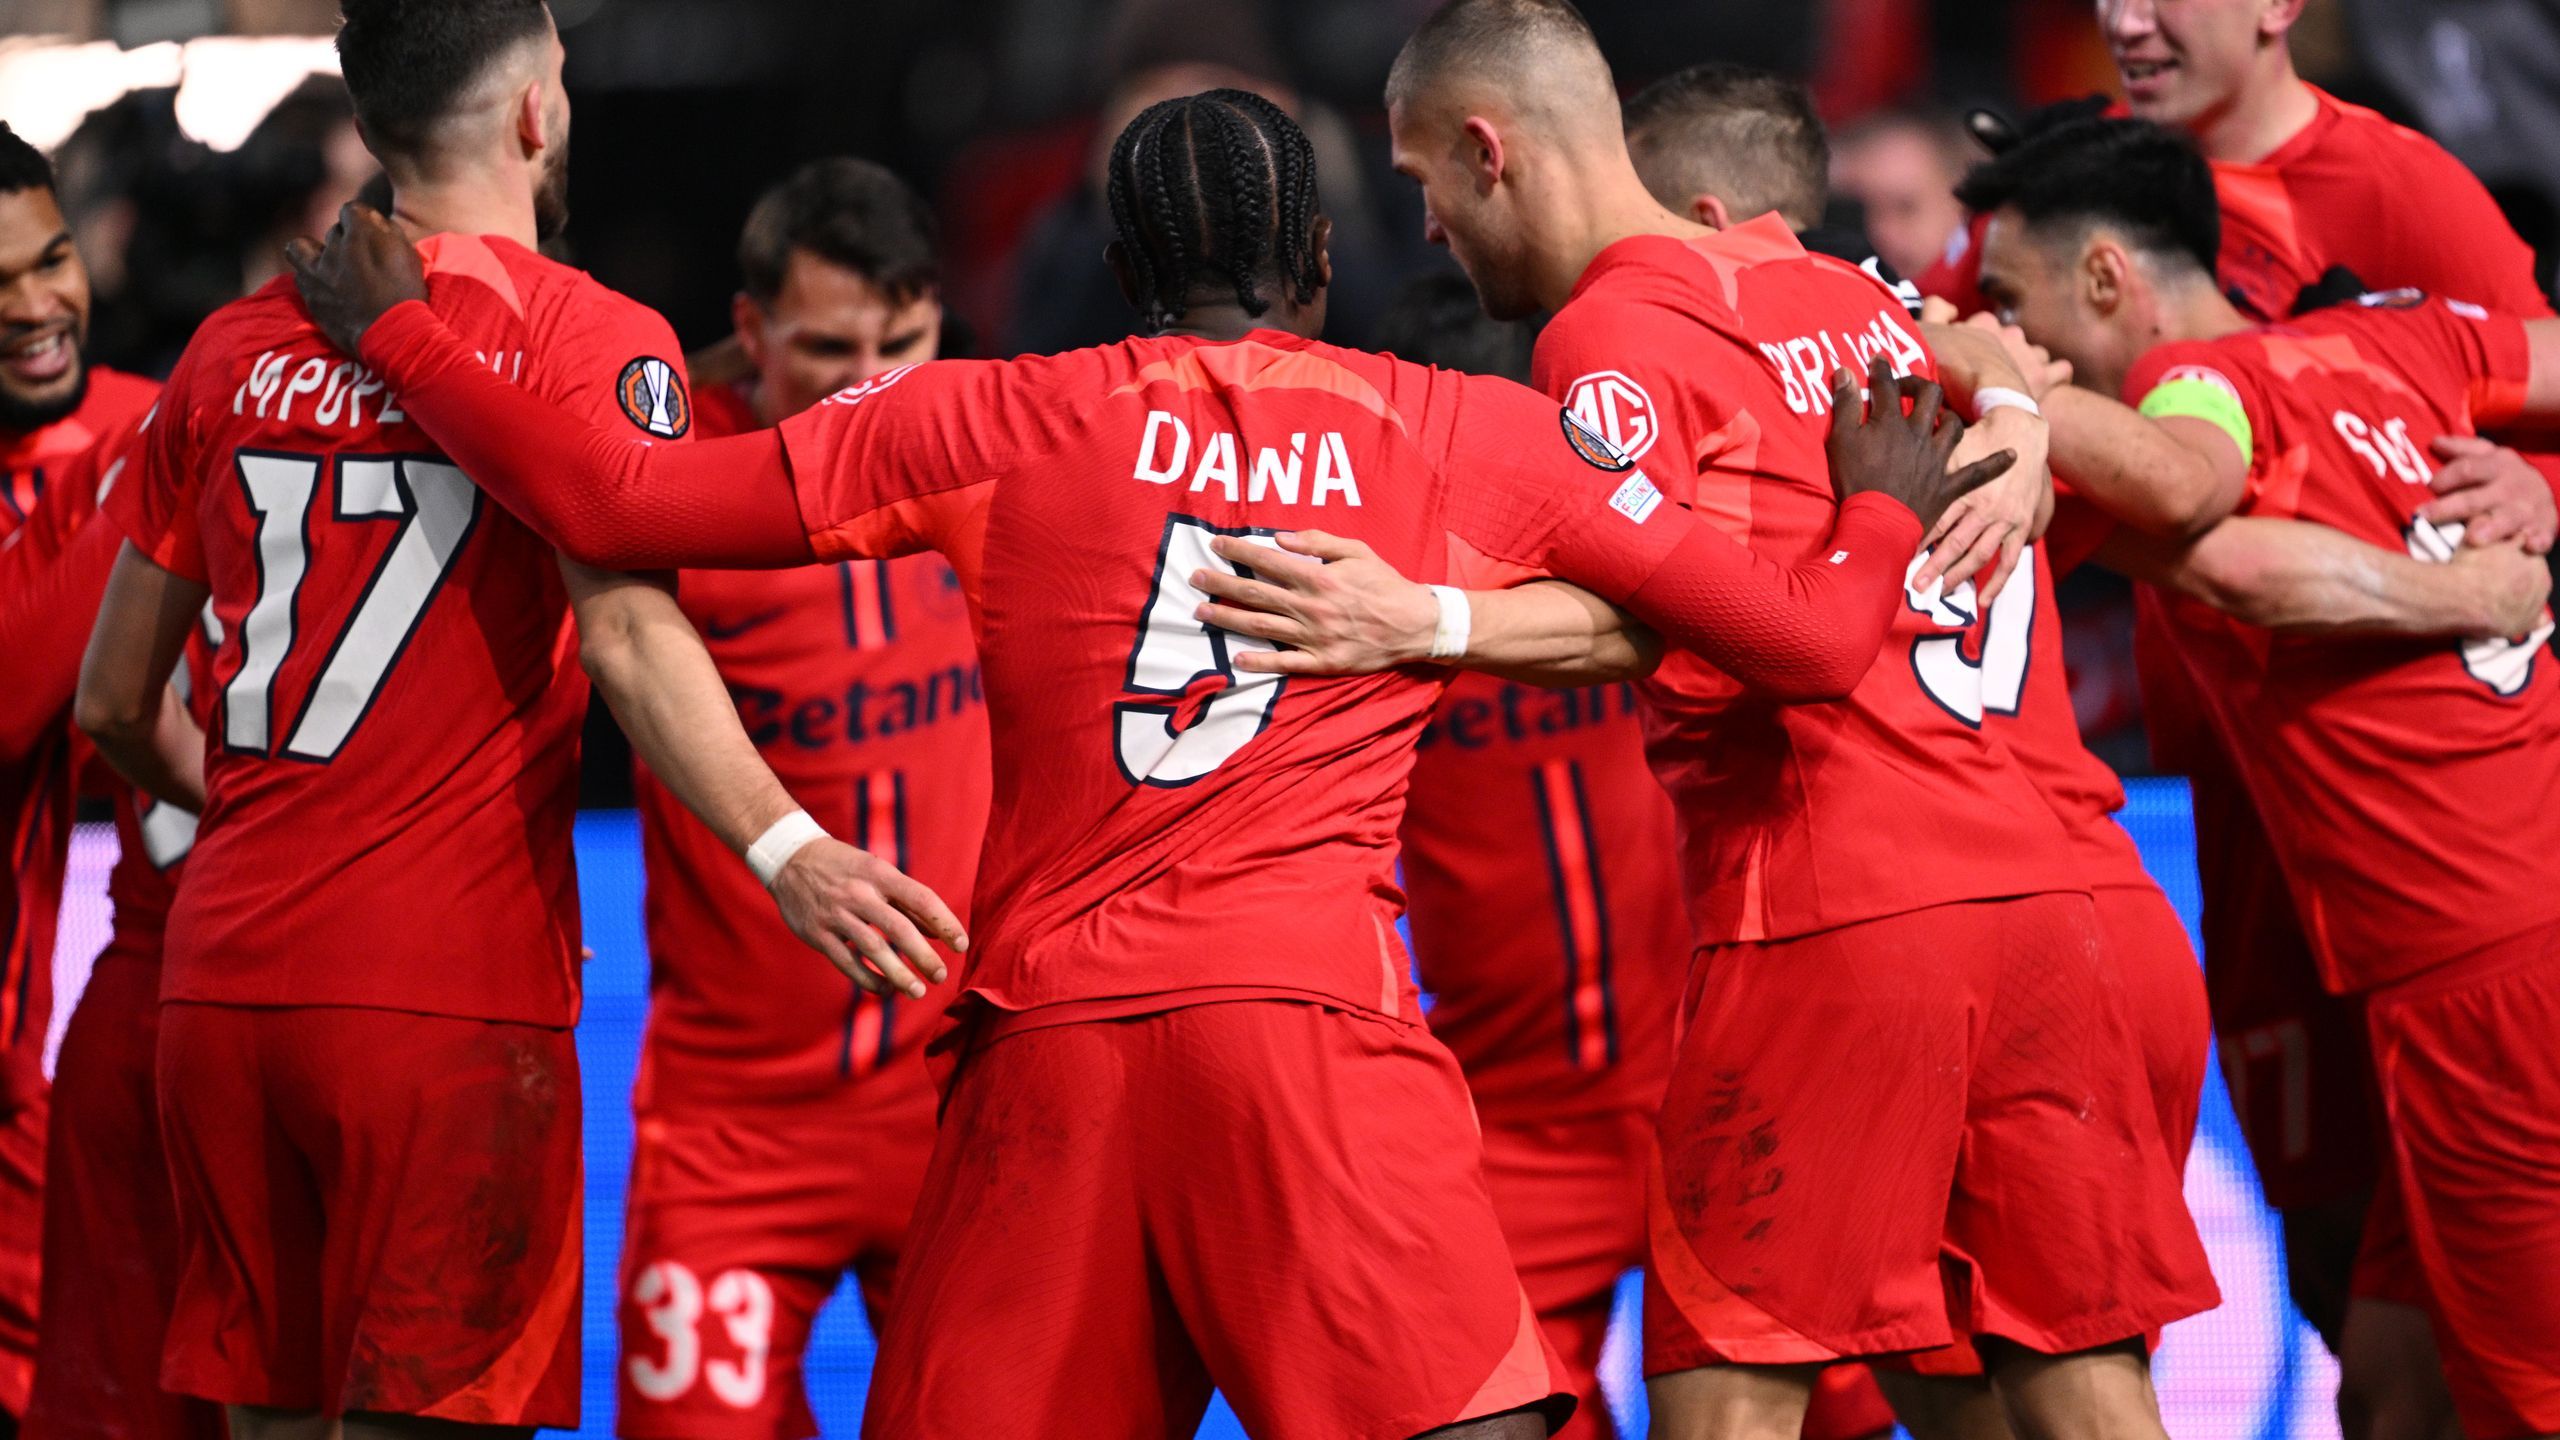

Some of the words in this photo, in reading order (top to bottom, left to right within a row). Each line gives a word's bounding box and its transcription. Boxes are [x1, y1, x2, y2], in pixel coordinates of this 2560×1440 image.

[1133, 410, 1362, 507] DAWA
[222, 448, 482, 764] 17
[1113, 512, 1328, 789] 5
[629, 1260, 774, 1409] 33
